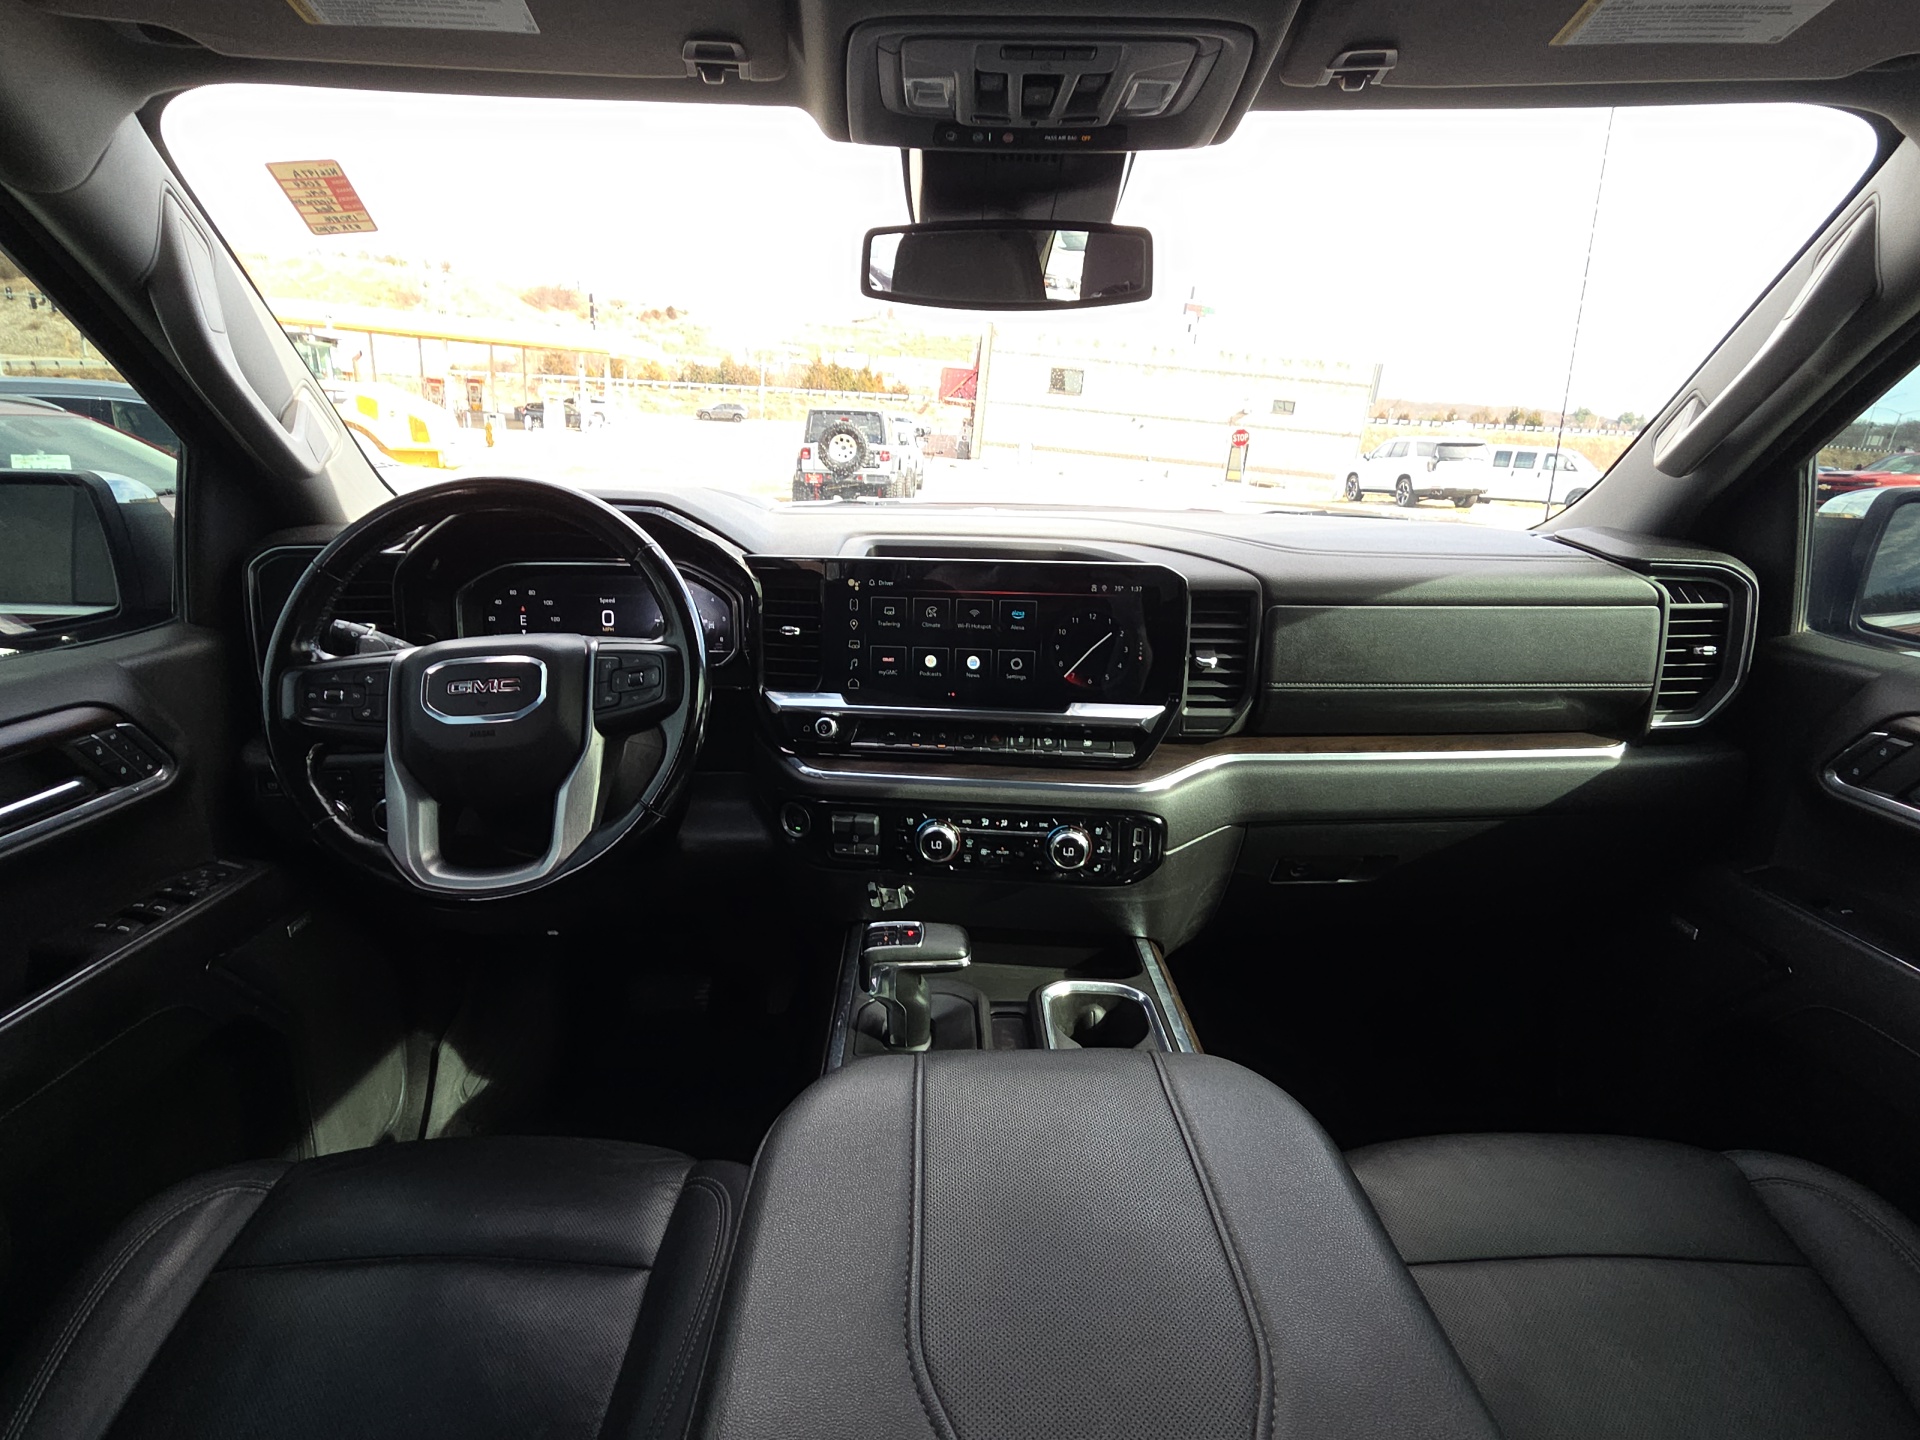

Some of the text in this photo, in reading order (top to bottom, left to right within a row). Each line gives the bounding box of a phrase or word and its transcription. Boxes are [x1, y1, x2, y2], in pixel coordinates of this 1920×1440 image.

[1232, 433, 1249, 442] STOP
[878, 579, 894, 587] Driver
[599, 597, 616, 605] Speed
[520, 614, 527, 626] E
[601, 609, 615, 627] 0
[877, 620, 901, 628] Trailering
[971, 623, 992, 631] Hotspot
[1058, 628, 1067, 636] 10
[1006, 673, 1027, 681] Settings
[447, 678, 521, 695] GMC
[931, 840, 942, 849] LO
[1062, 847, 1075, 856] LO
